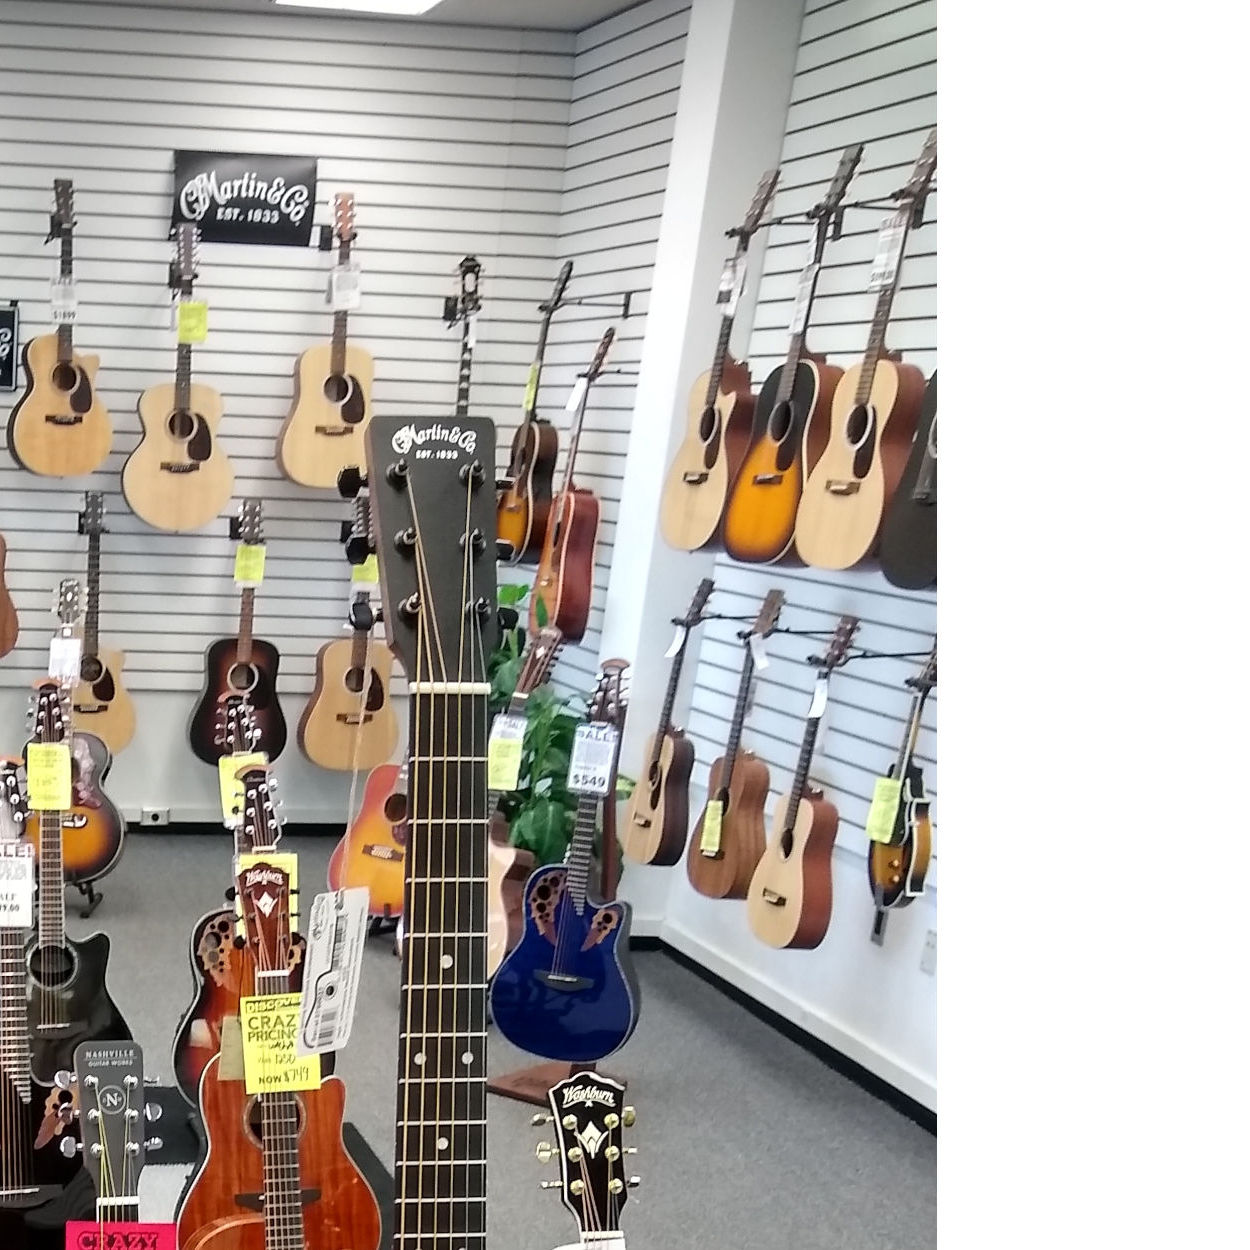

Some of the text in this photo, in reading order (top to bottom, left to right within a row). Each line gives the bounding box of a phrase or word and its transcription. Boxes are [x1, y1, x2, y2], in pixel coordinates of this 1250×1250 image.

[216, 207, 280, 224] EST. 1833
[247, 1014, 299, 1031] CRAZ
[85, 1049, 135, 1059] NASHVILLE
[258, 1075, 282, 1085] NOW
[562, 1085, 615, 1105] Washburn
